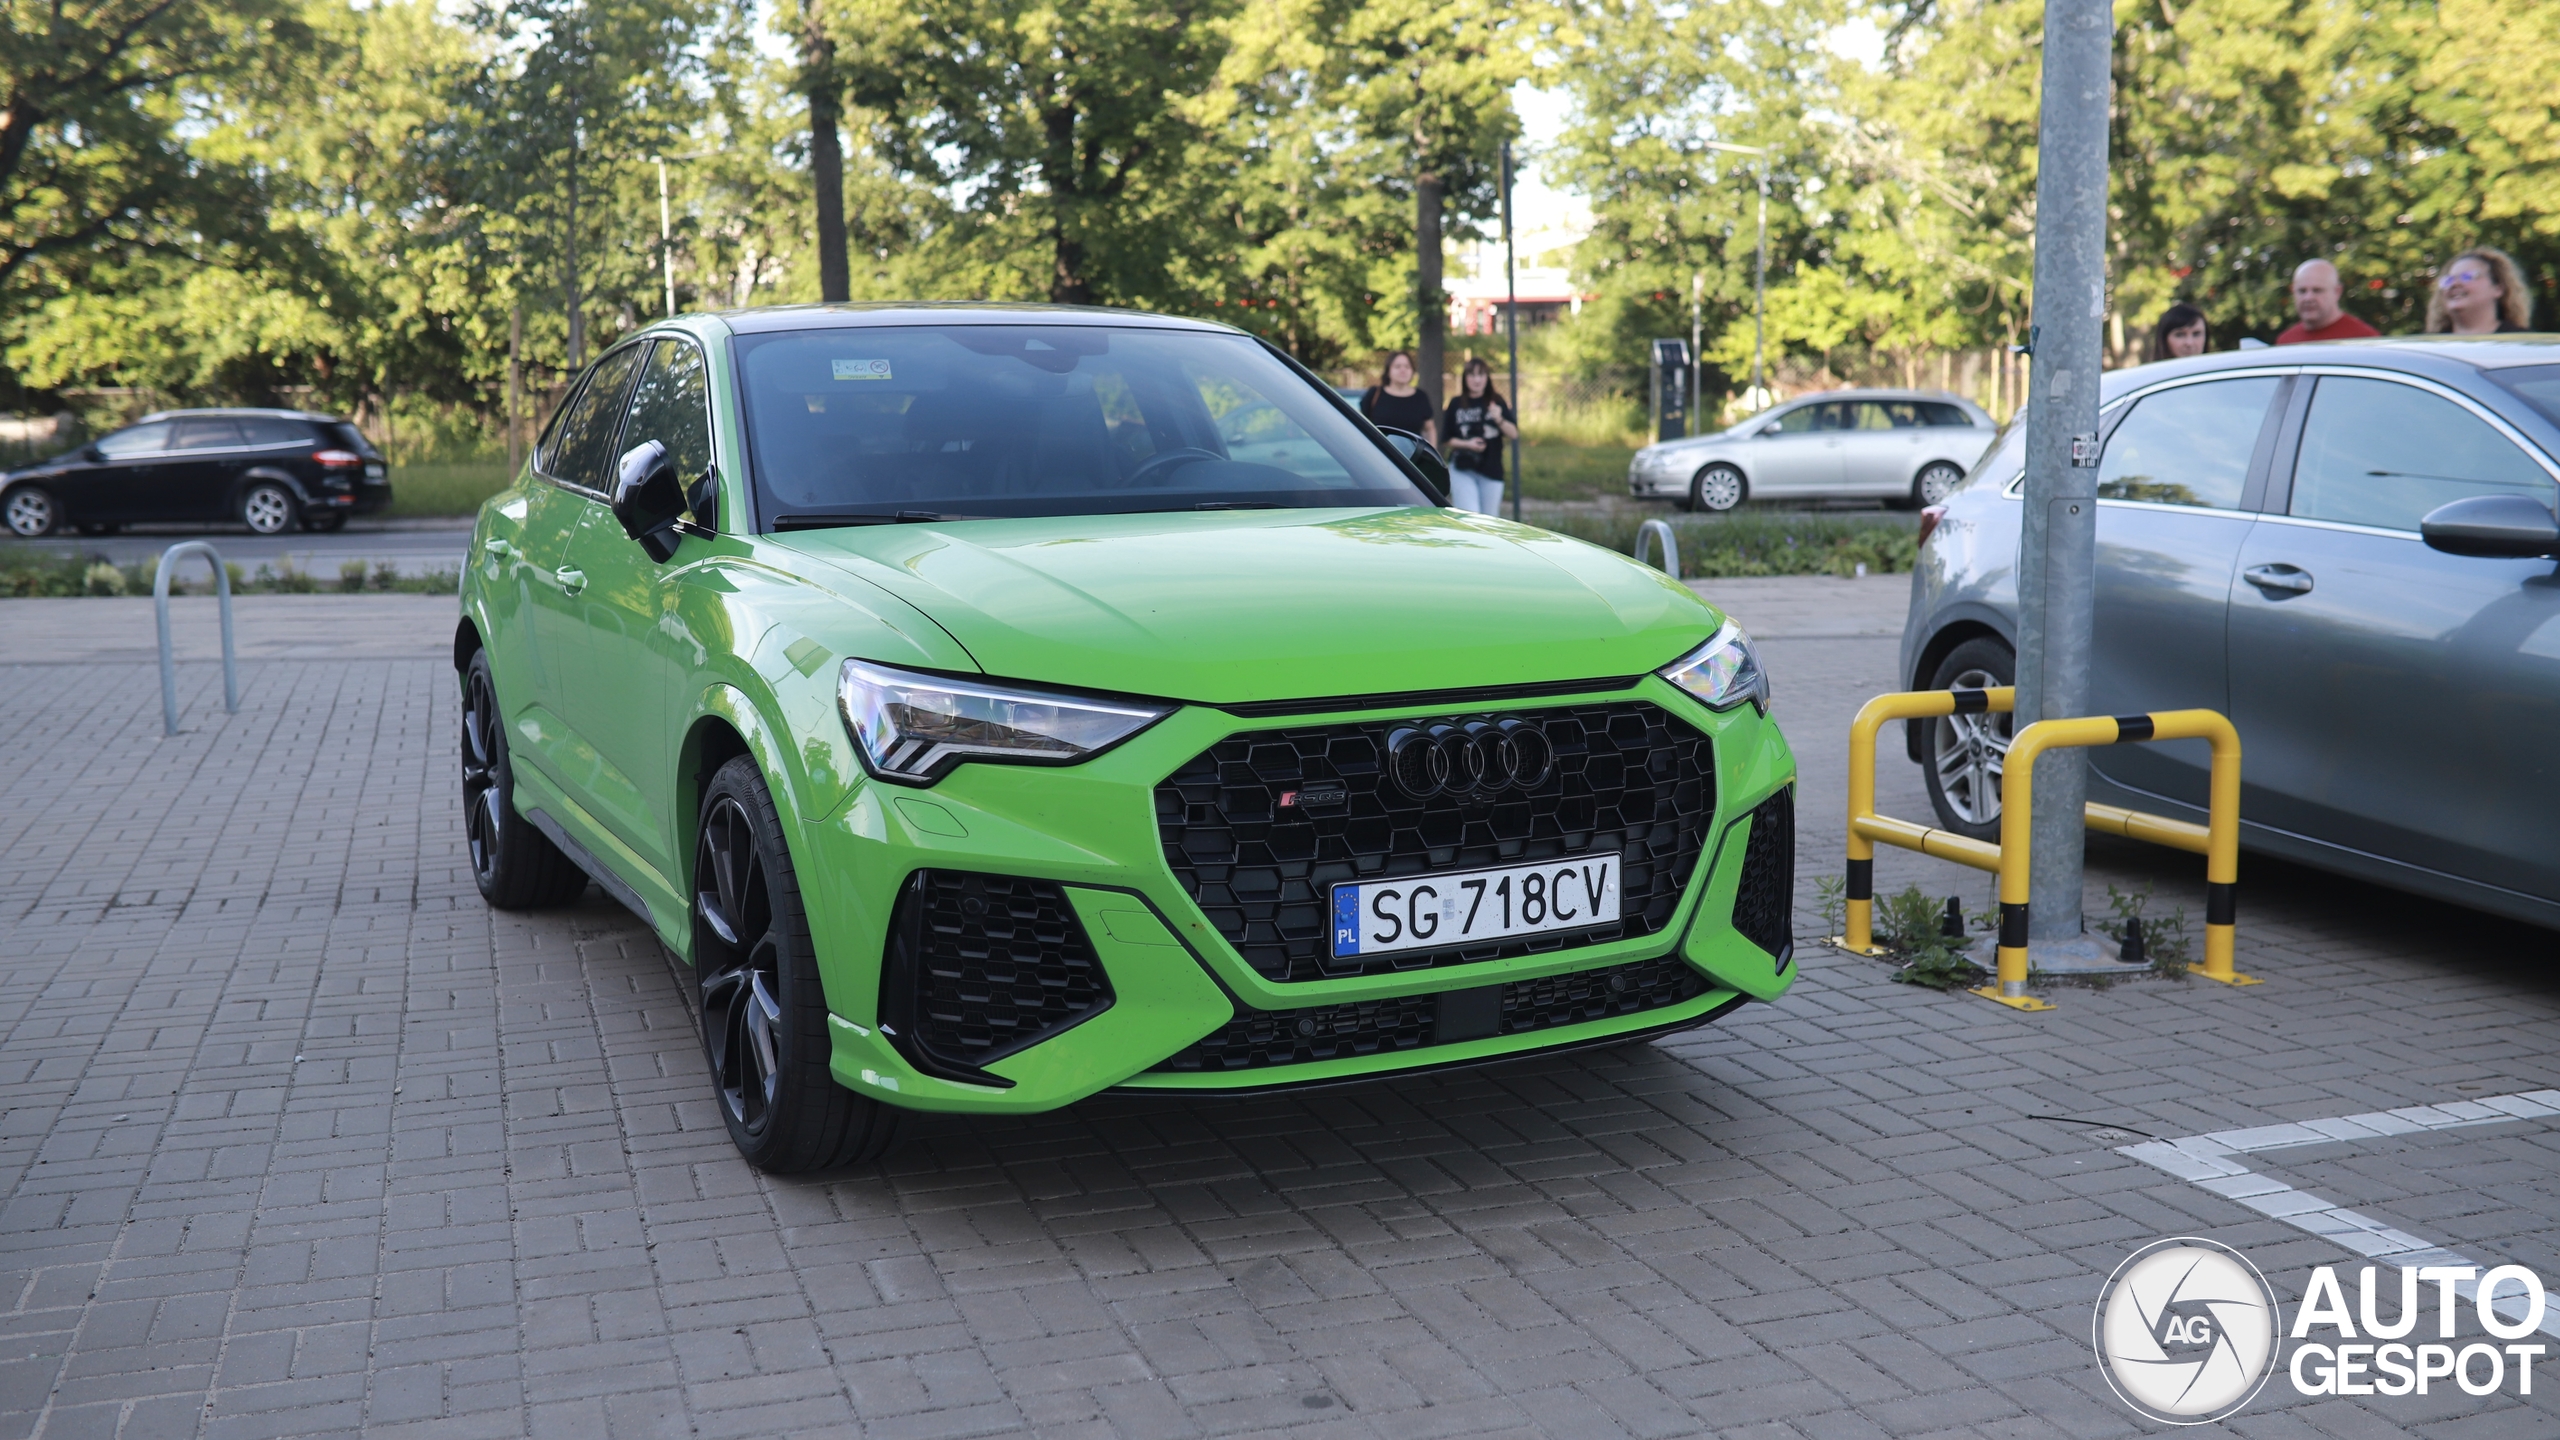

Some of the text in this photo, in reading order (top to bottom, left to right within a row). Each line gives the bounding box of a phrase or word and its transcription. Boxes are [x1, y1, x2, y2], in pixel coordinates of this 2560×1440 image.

[1372, 863, 1608, 944] SG 718CV
[1338, 928, 1356, 944] PL
